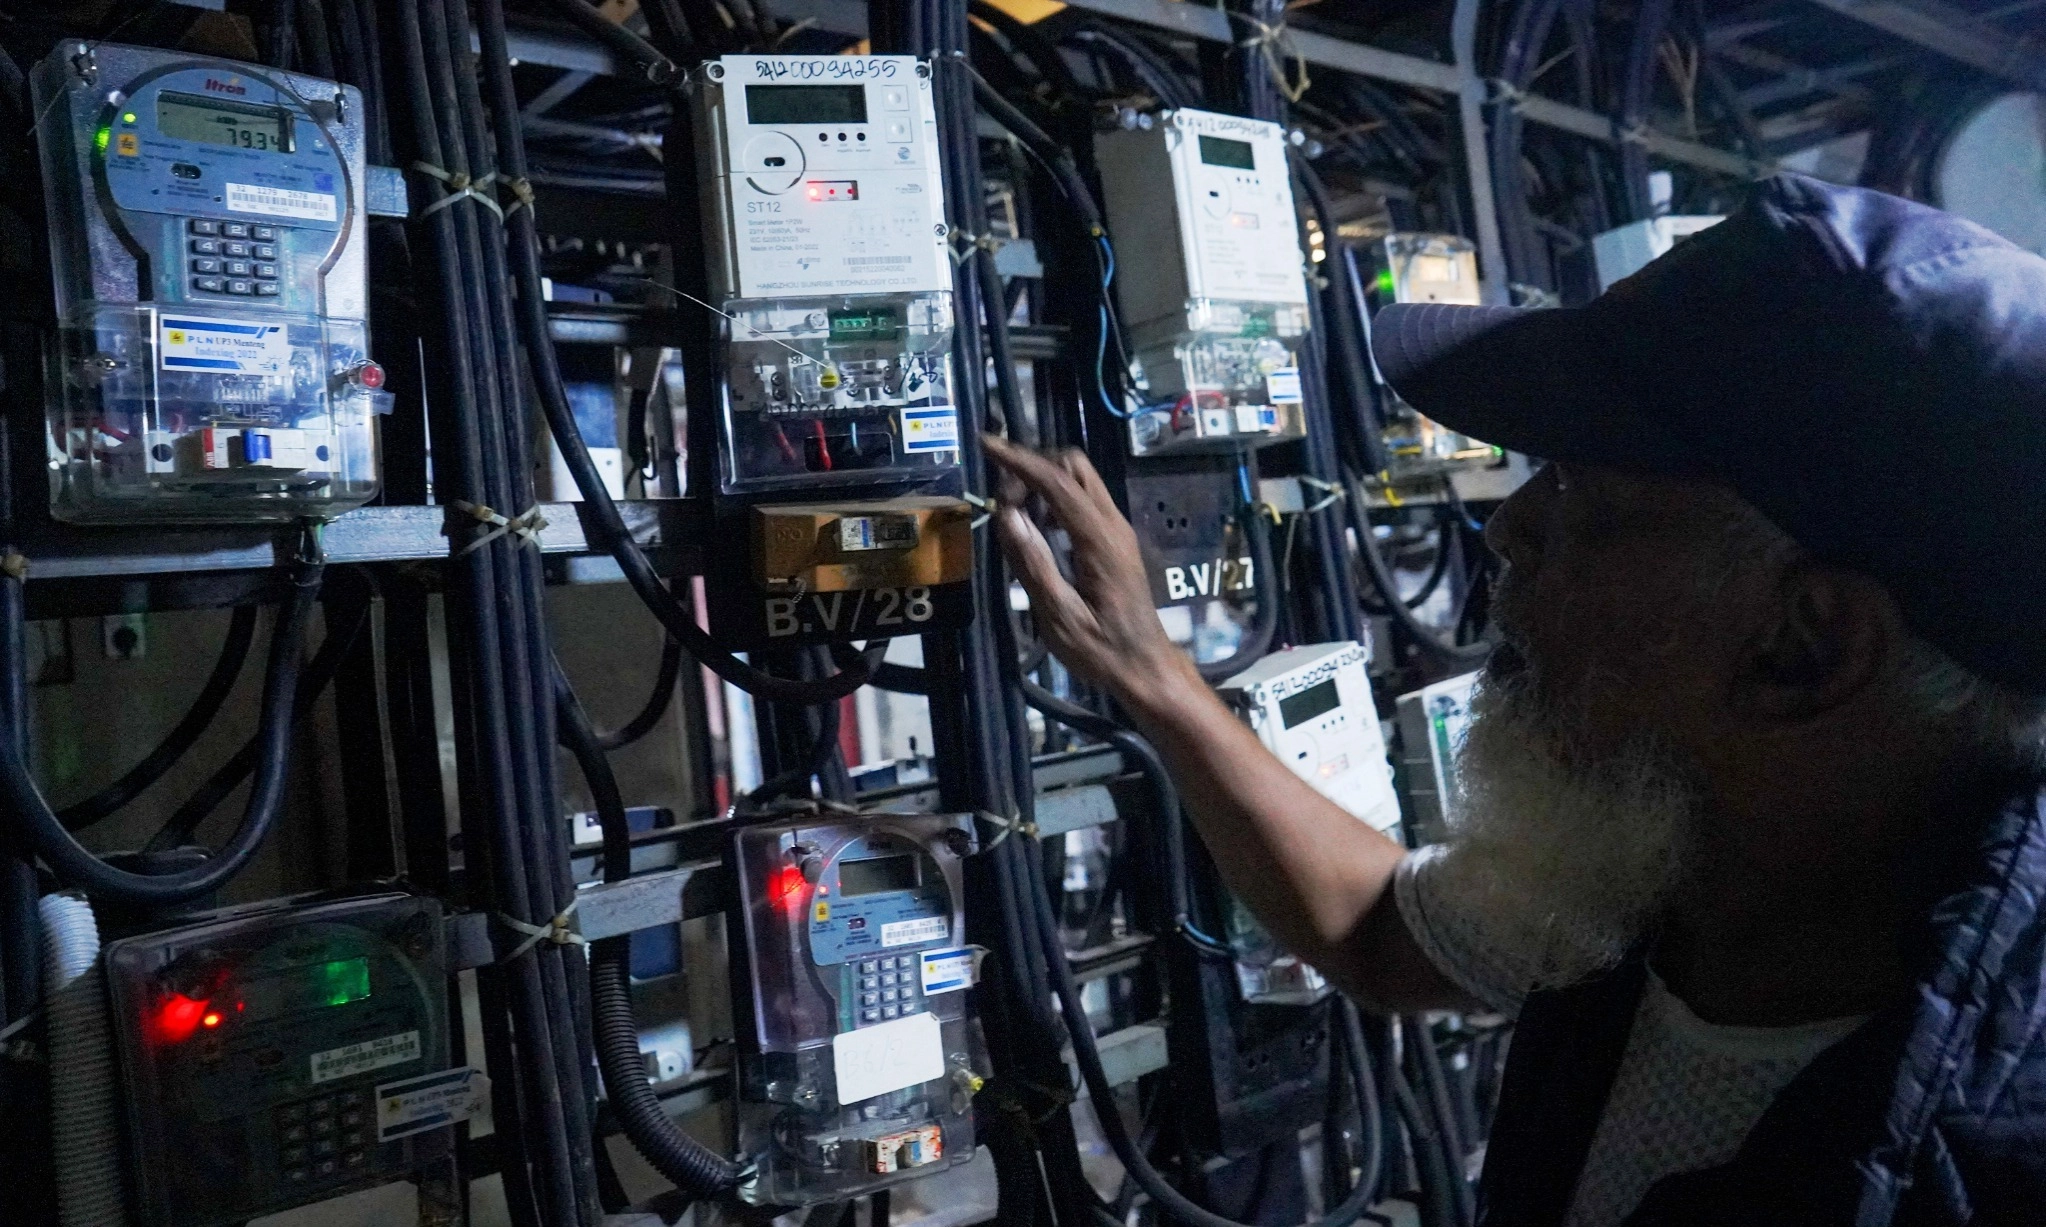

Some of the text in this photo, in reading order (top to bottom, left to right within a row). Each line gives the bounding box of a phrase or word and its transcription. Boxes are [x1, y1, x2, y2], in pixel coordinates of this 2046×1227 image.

[205, 78, 247, 95] Itron
[747, 201, 781, 213] ST12
[203, 223, 272, 237] 1 2 3
[202, 242, 272, 256] 4 5 6
[203, 261, 274, 275] 7 8 9
[835, 279, 886, 288] TECHNOLOGY
[215, 337, 232, 346] UP3
[233, 338, 266, 350] Menteng
[195, 346, 258, 359] Indexing 2022
[765, 586, 934, 638] B.V/28
